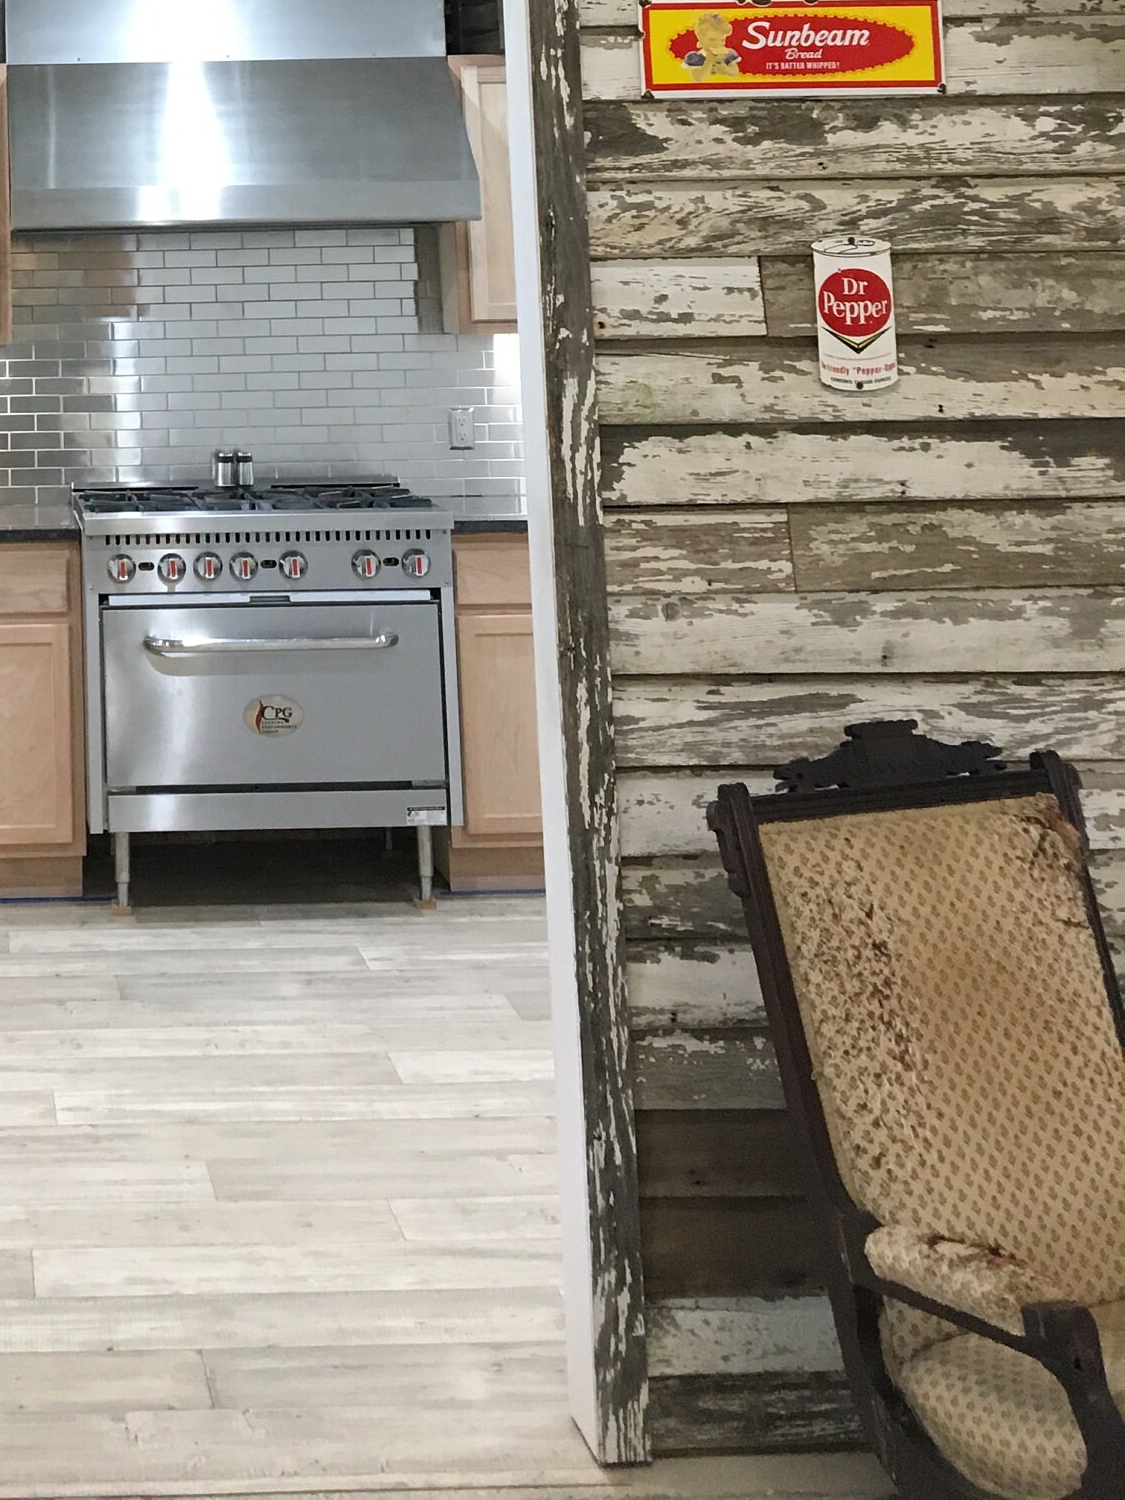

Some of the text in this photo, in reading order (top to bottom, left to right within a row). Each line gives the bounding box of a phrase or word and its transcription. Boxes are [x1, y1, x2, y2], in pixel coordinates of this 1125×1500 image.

[742, 20, 870, 50] Sunbeam
[785, 47, 823, 60] Bread
[765, 62, 779, 70] IT'S
[806, 61, 840, 69] WHIPPED!
[841, 277, 869, 296] Dr
[823, 290, 888, 326] Pepper
[261, 705, 293, 723] CPG
